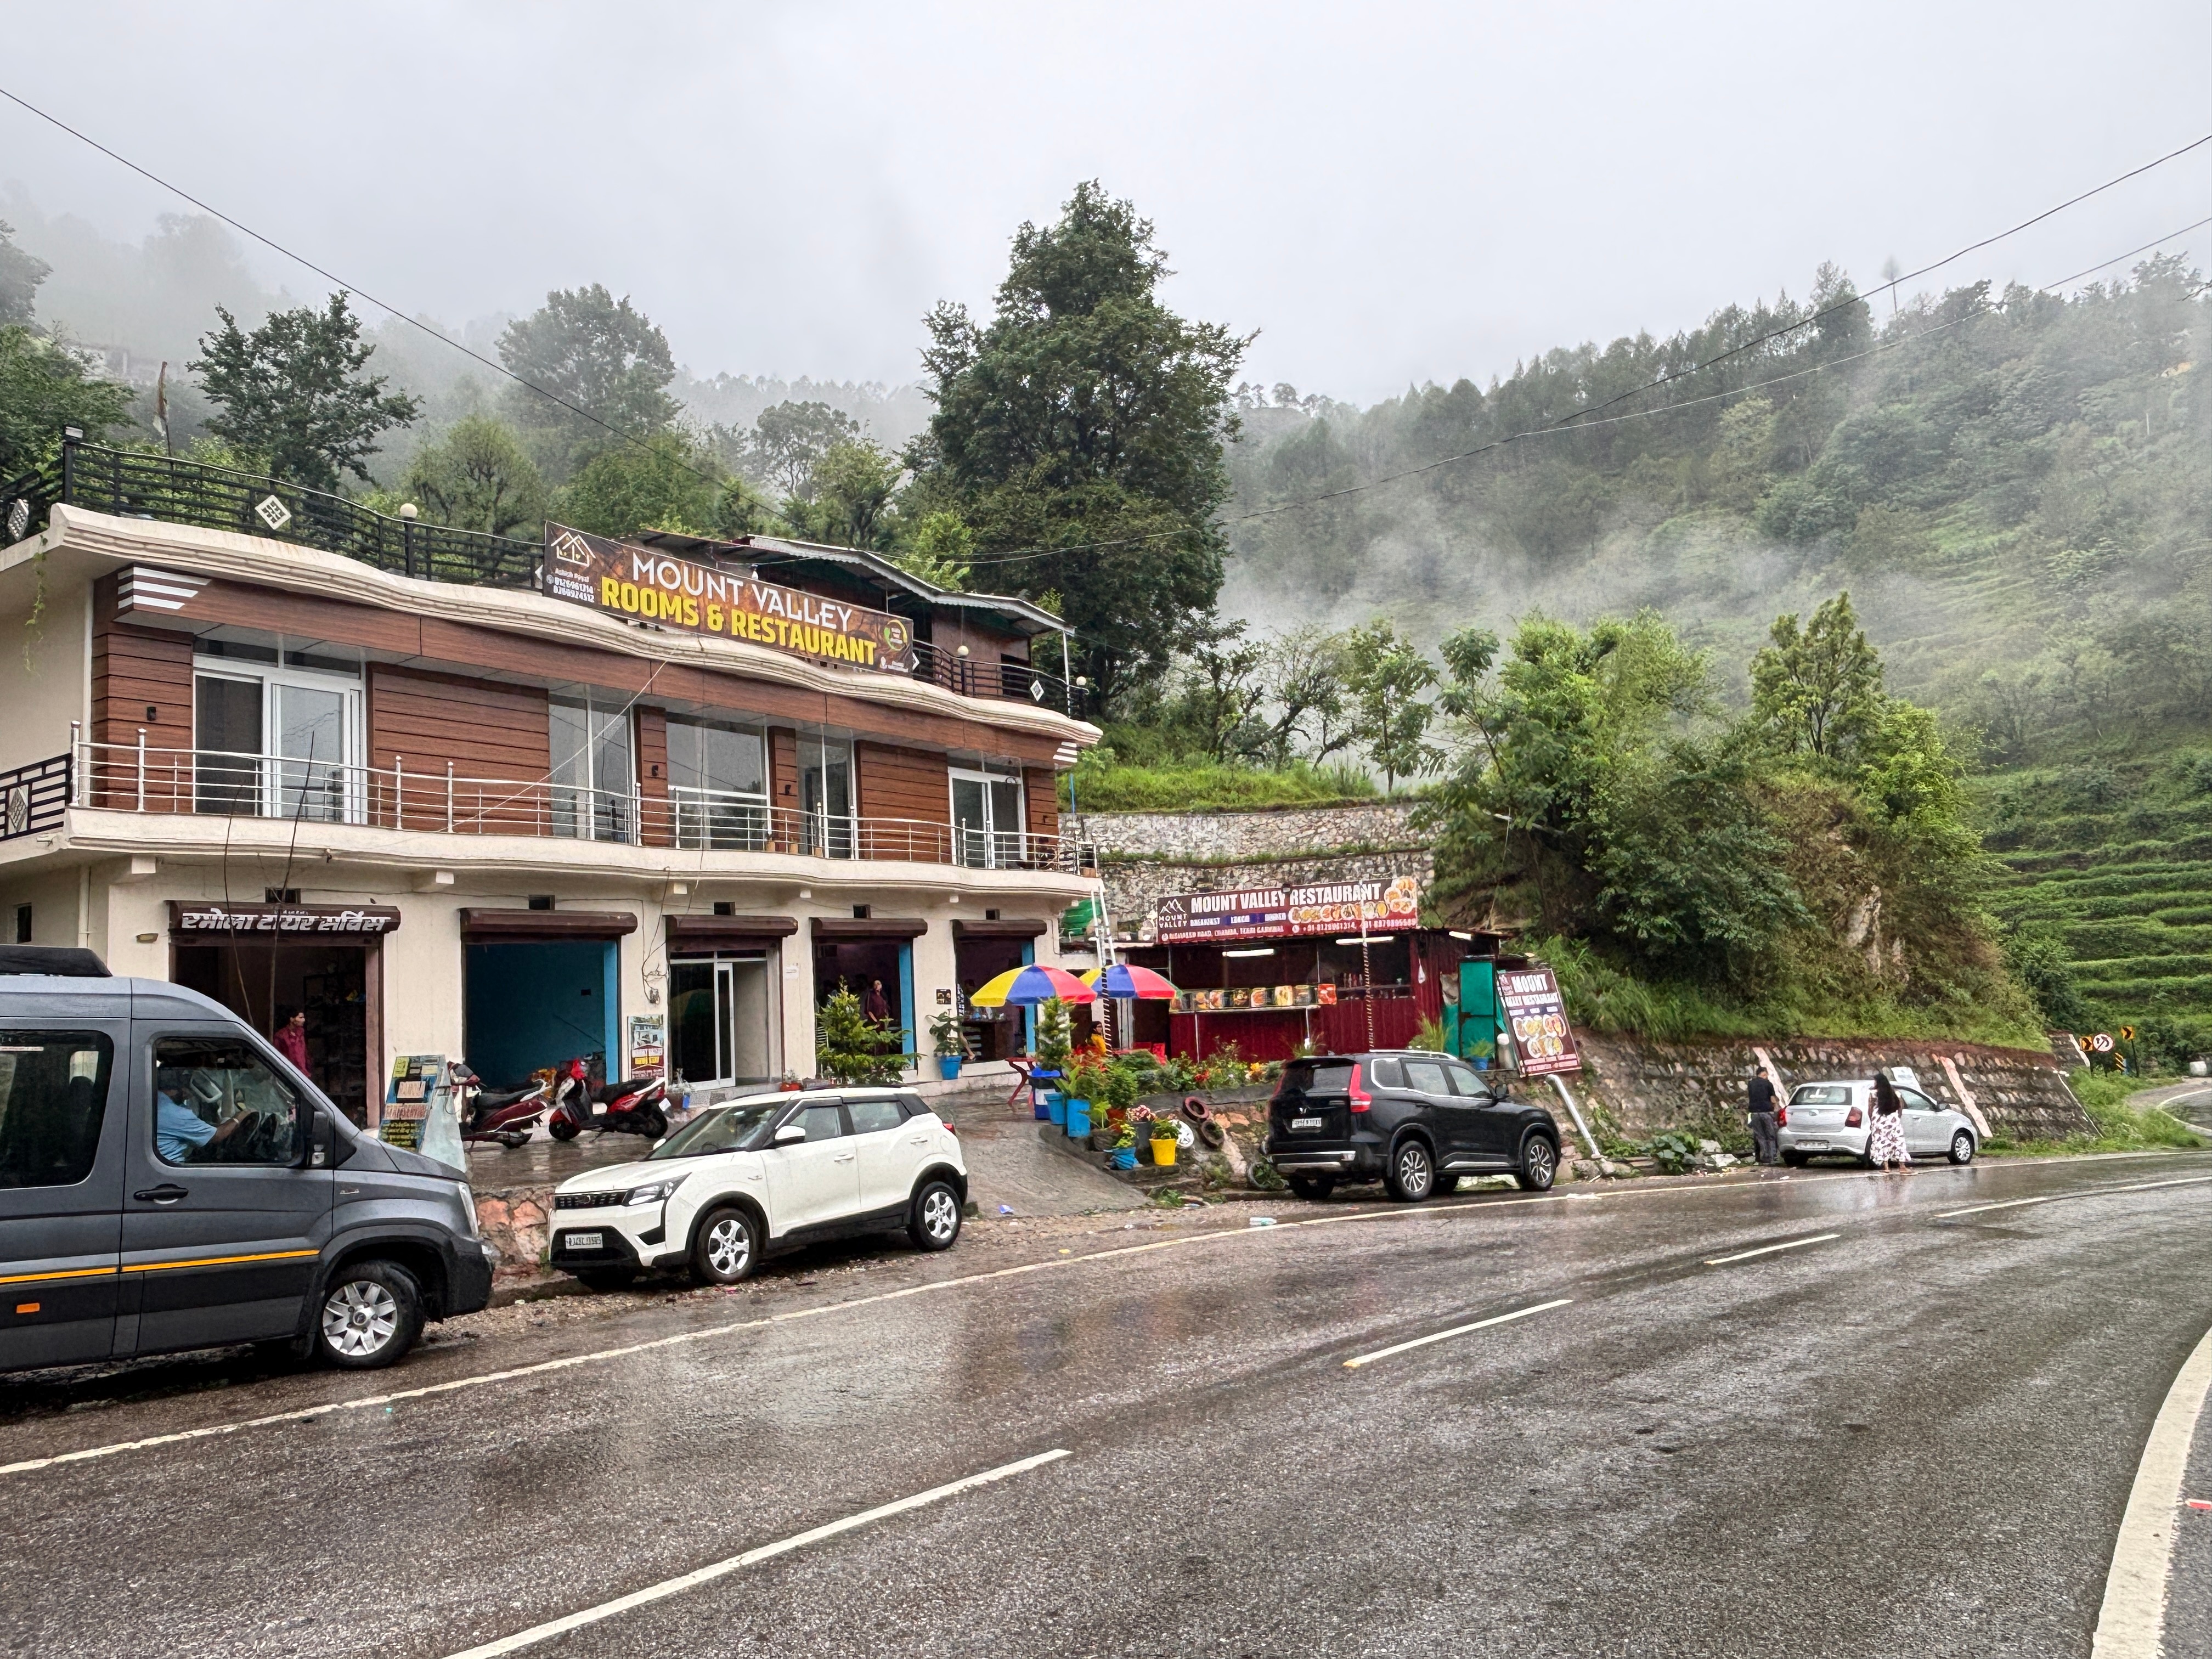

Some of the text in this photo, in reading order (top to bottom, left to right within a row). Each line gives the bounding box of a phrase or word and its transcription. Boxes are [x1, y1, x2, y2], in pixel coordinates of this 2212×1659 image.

[633, 552, 853, 632] MOUNT VALLEY
[601, 576, 877, 665] ROOMS & RESTAURANT
[1191, 883, 1381, 913] MOUNT VALLEY RESTAURANT
[257, 914, 319, 930] टायर
[318, 911, 391, 931] सर्विस
[1159, 913, 1187, 922] MOUNT
[1511, 974, 1548, 992] MOUNT
